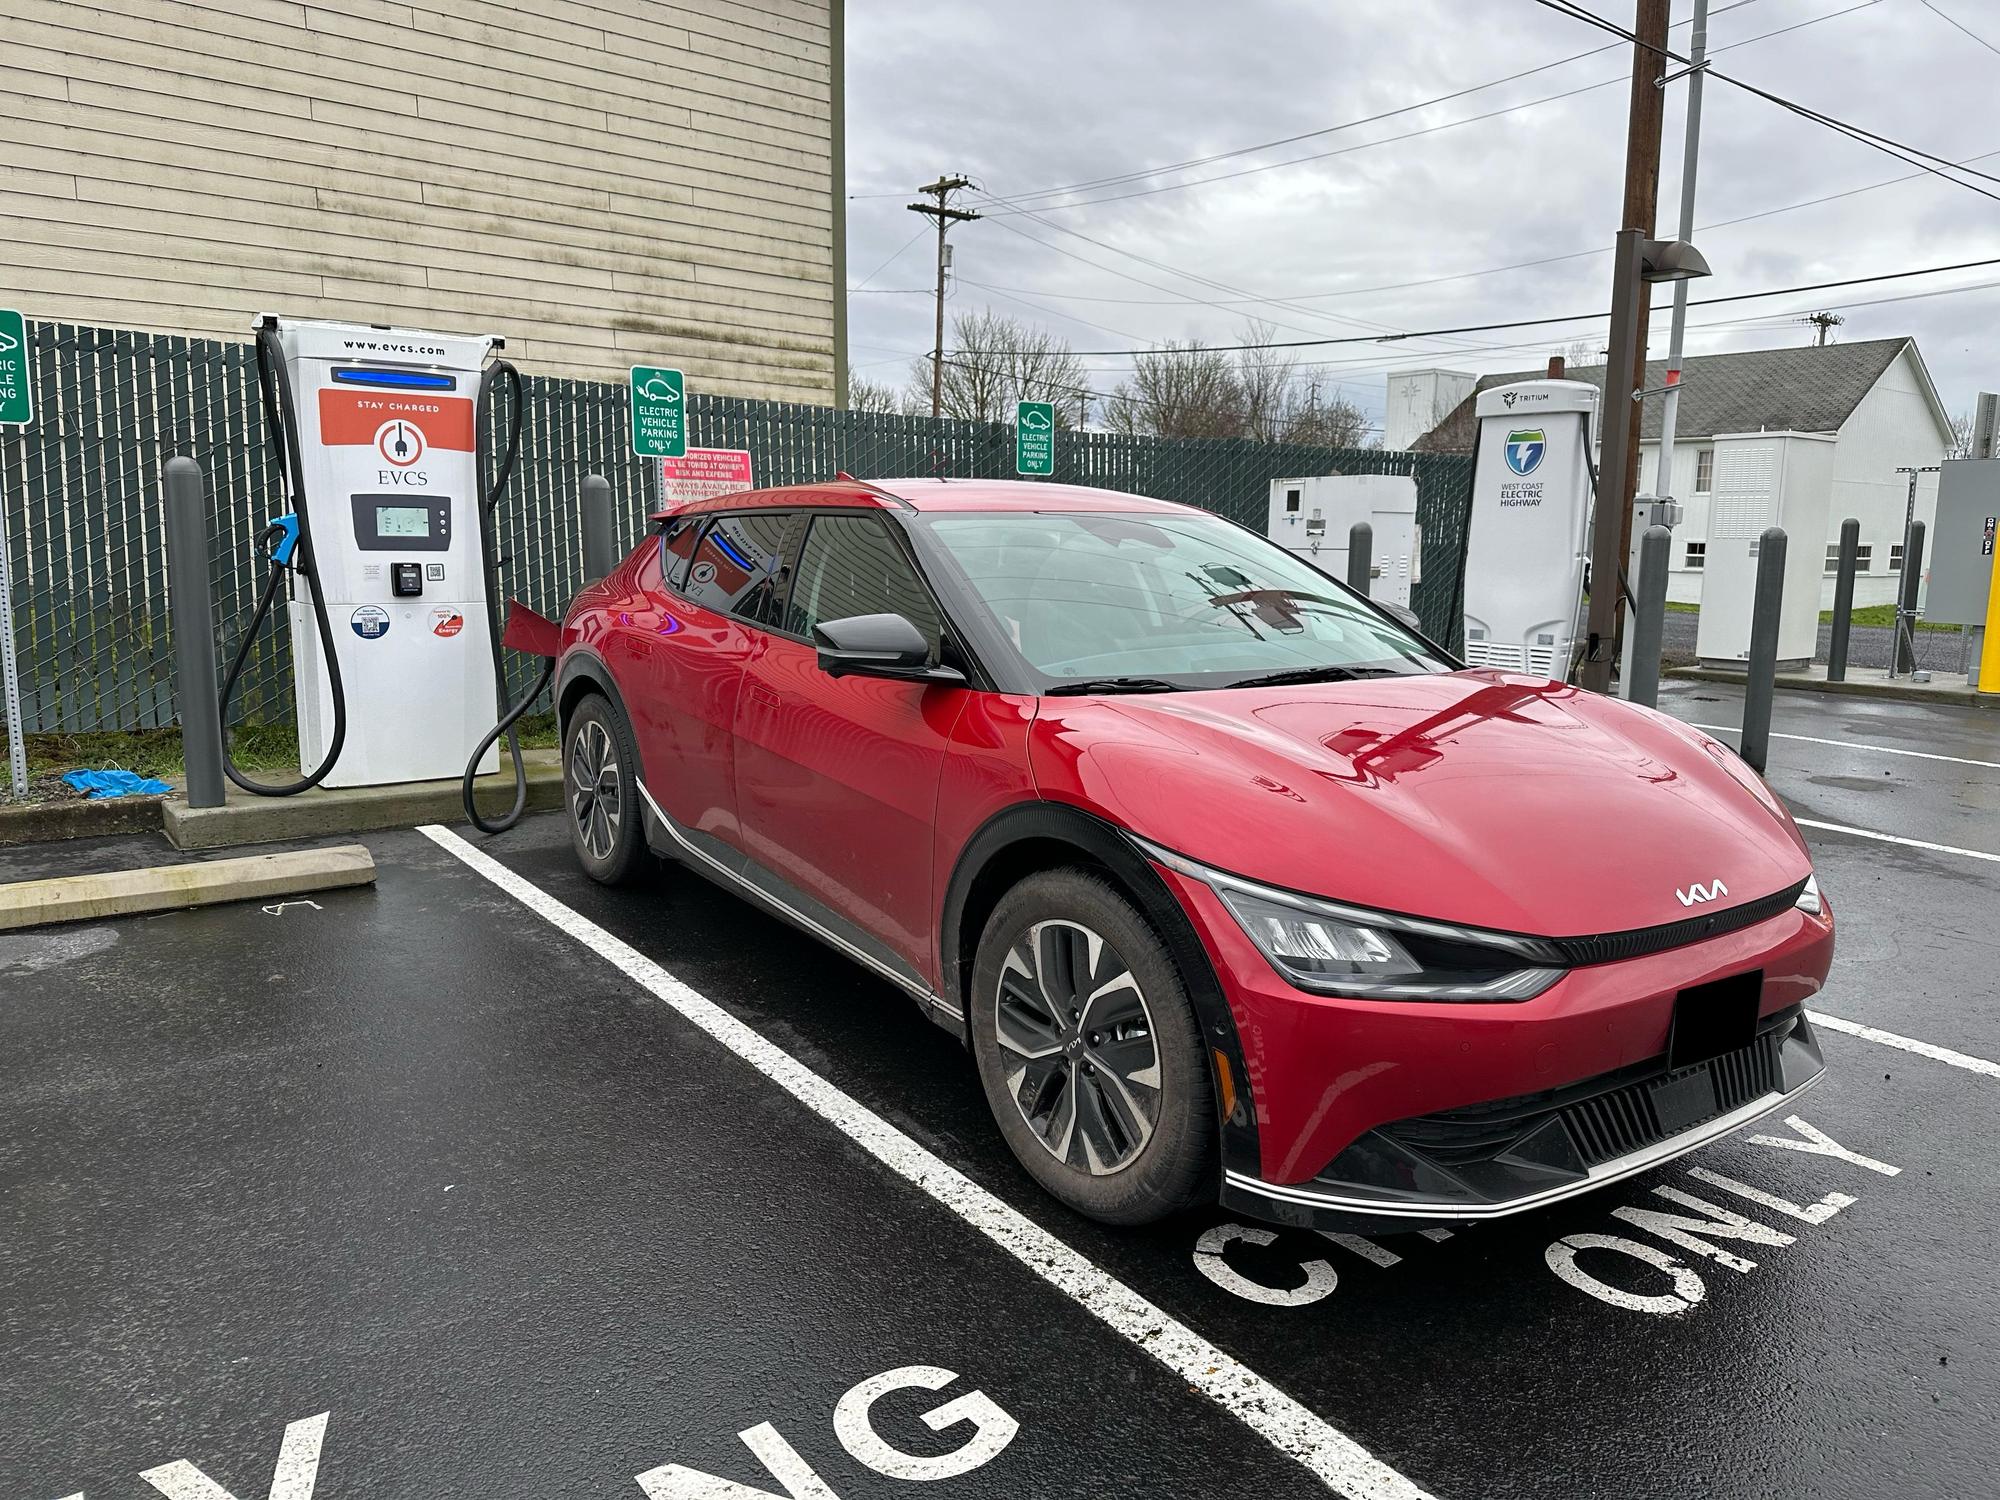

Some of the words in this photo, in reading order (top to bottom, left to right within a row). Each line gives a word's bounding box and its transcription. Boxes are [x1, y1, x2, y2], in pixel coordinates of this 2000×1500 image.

[343, 340, 446, 356] www.evcs.com
[1520, 394, 1549, 402] TRITIUM
[357, 400, 384, 409] STAY
[388, 402, 440, 413] CHARGED
[639, 405, 679, 418] ELECTRIC
[641, 417, 677, 428] VEHICLE
[641, 428, 678, 439] PARKING
[1022, 433, 1048, 442] ELECTRIC
[648, 439, 671, 449] ONLY
[1023, 442, 1047, 451] VEHICLE
[1022, 451, 1048, 459] PARKING
[378, 470, 428, 486] EVCS
[1521, 482, 1544, 490] COAST
[1500, 490, 1543, 499] ELECTRIC
[1500, 499, 1542, 507] HIGHWAY
[1545, 1114, 1901, 1316] ONLY
